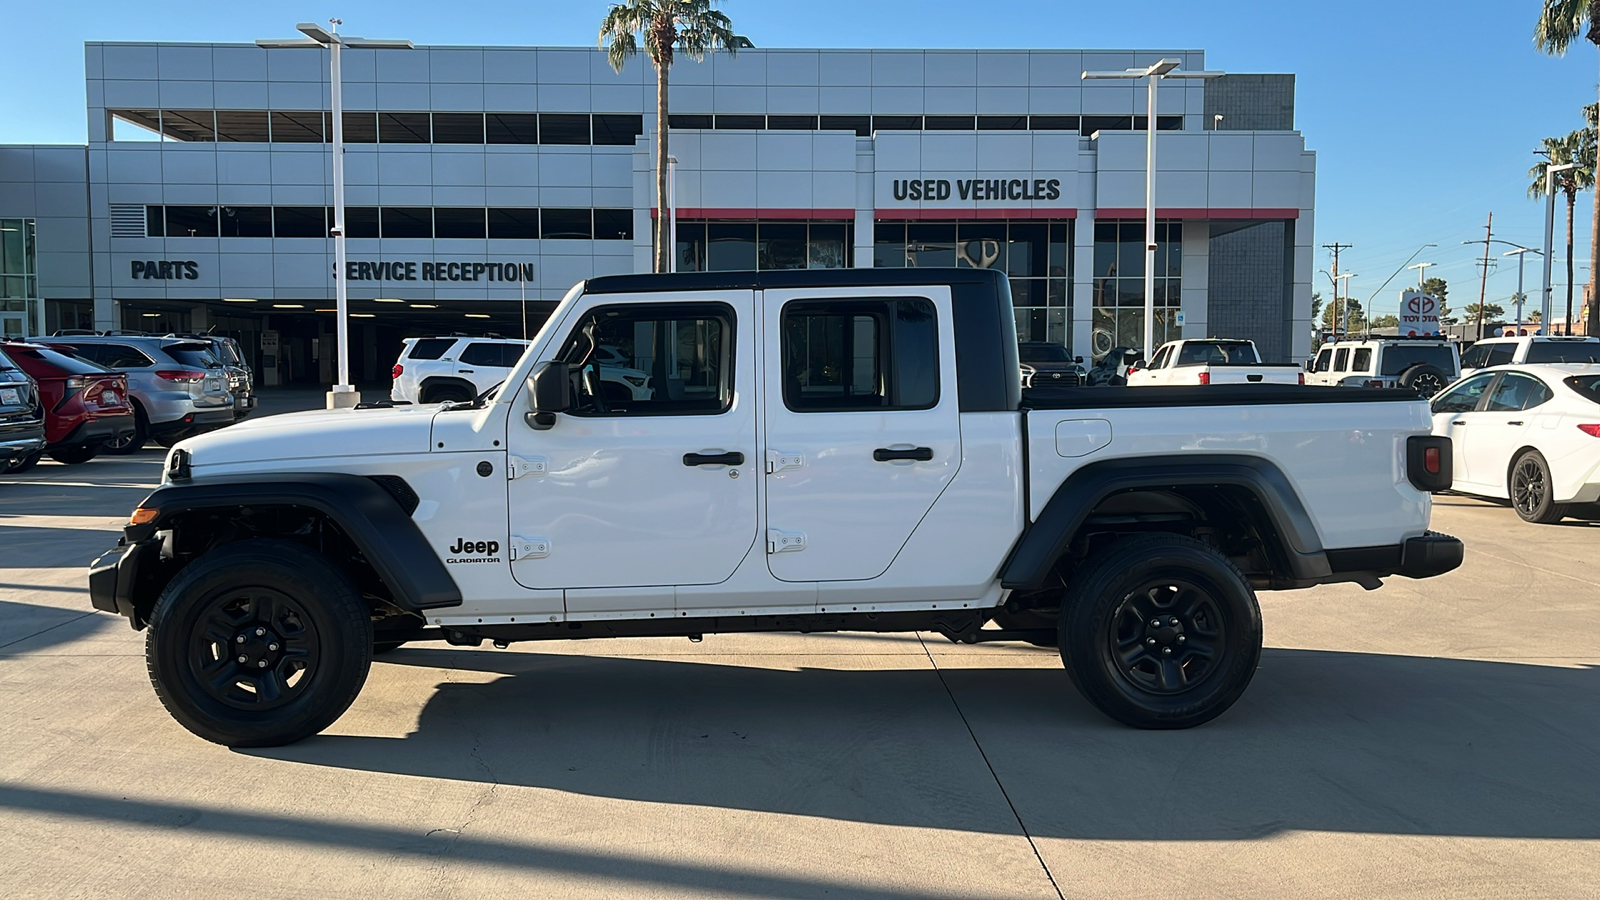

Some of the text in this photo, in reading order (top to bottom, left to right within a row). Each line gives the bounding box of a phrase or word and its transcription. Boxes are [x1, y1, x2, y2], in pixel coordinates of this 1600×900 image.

[893, 179, 1061, 201] USED VEHICLES
[131, 260, 199, 280] PARTS
[422, 262, 534, 282] RECEPTION
[1403, 315, 1439, 323] TOYOTA
[449, 537, 500, 557] Jeep
